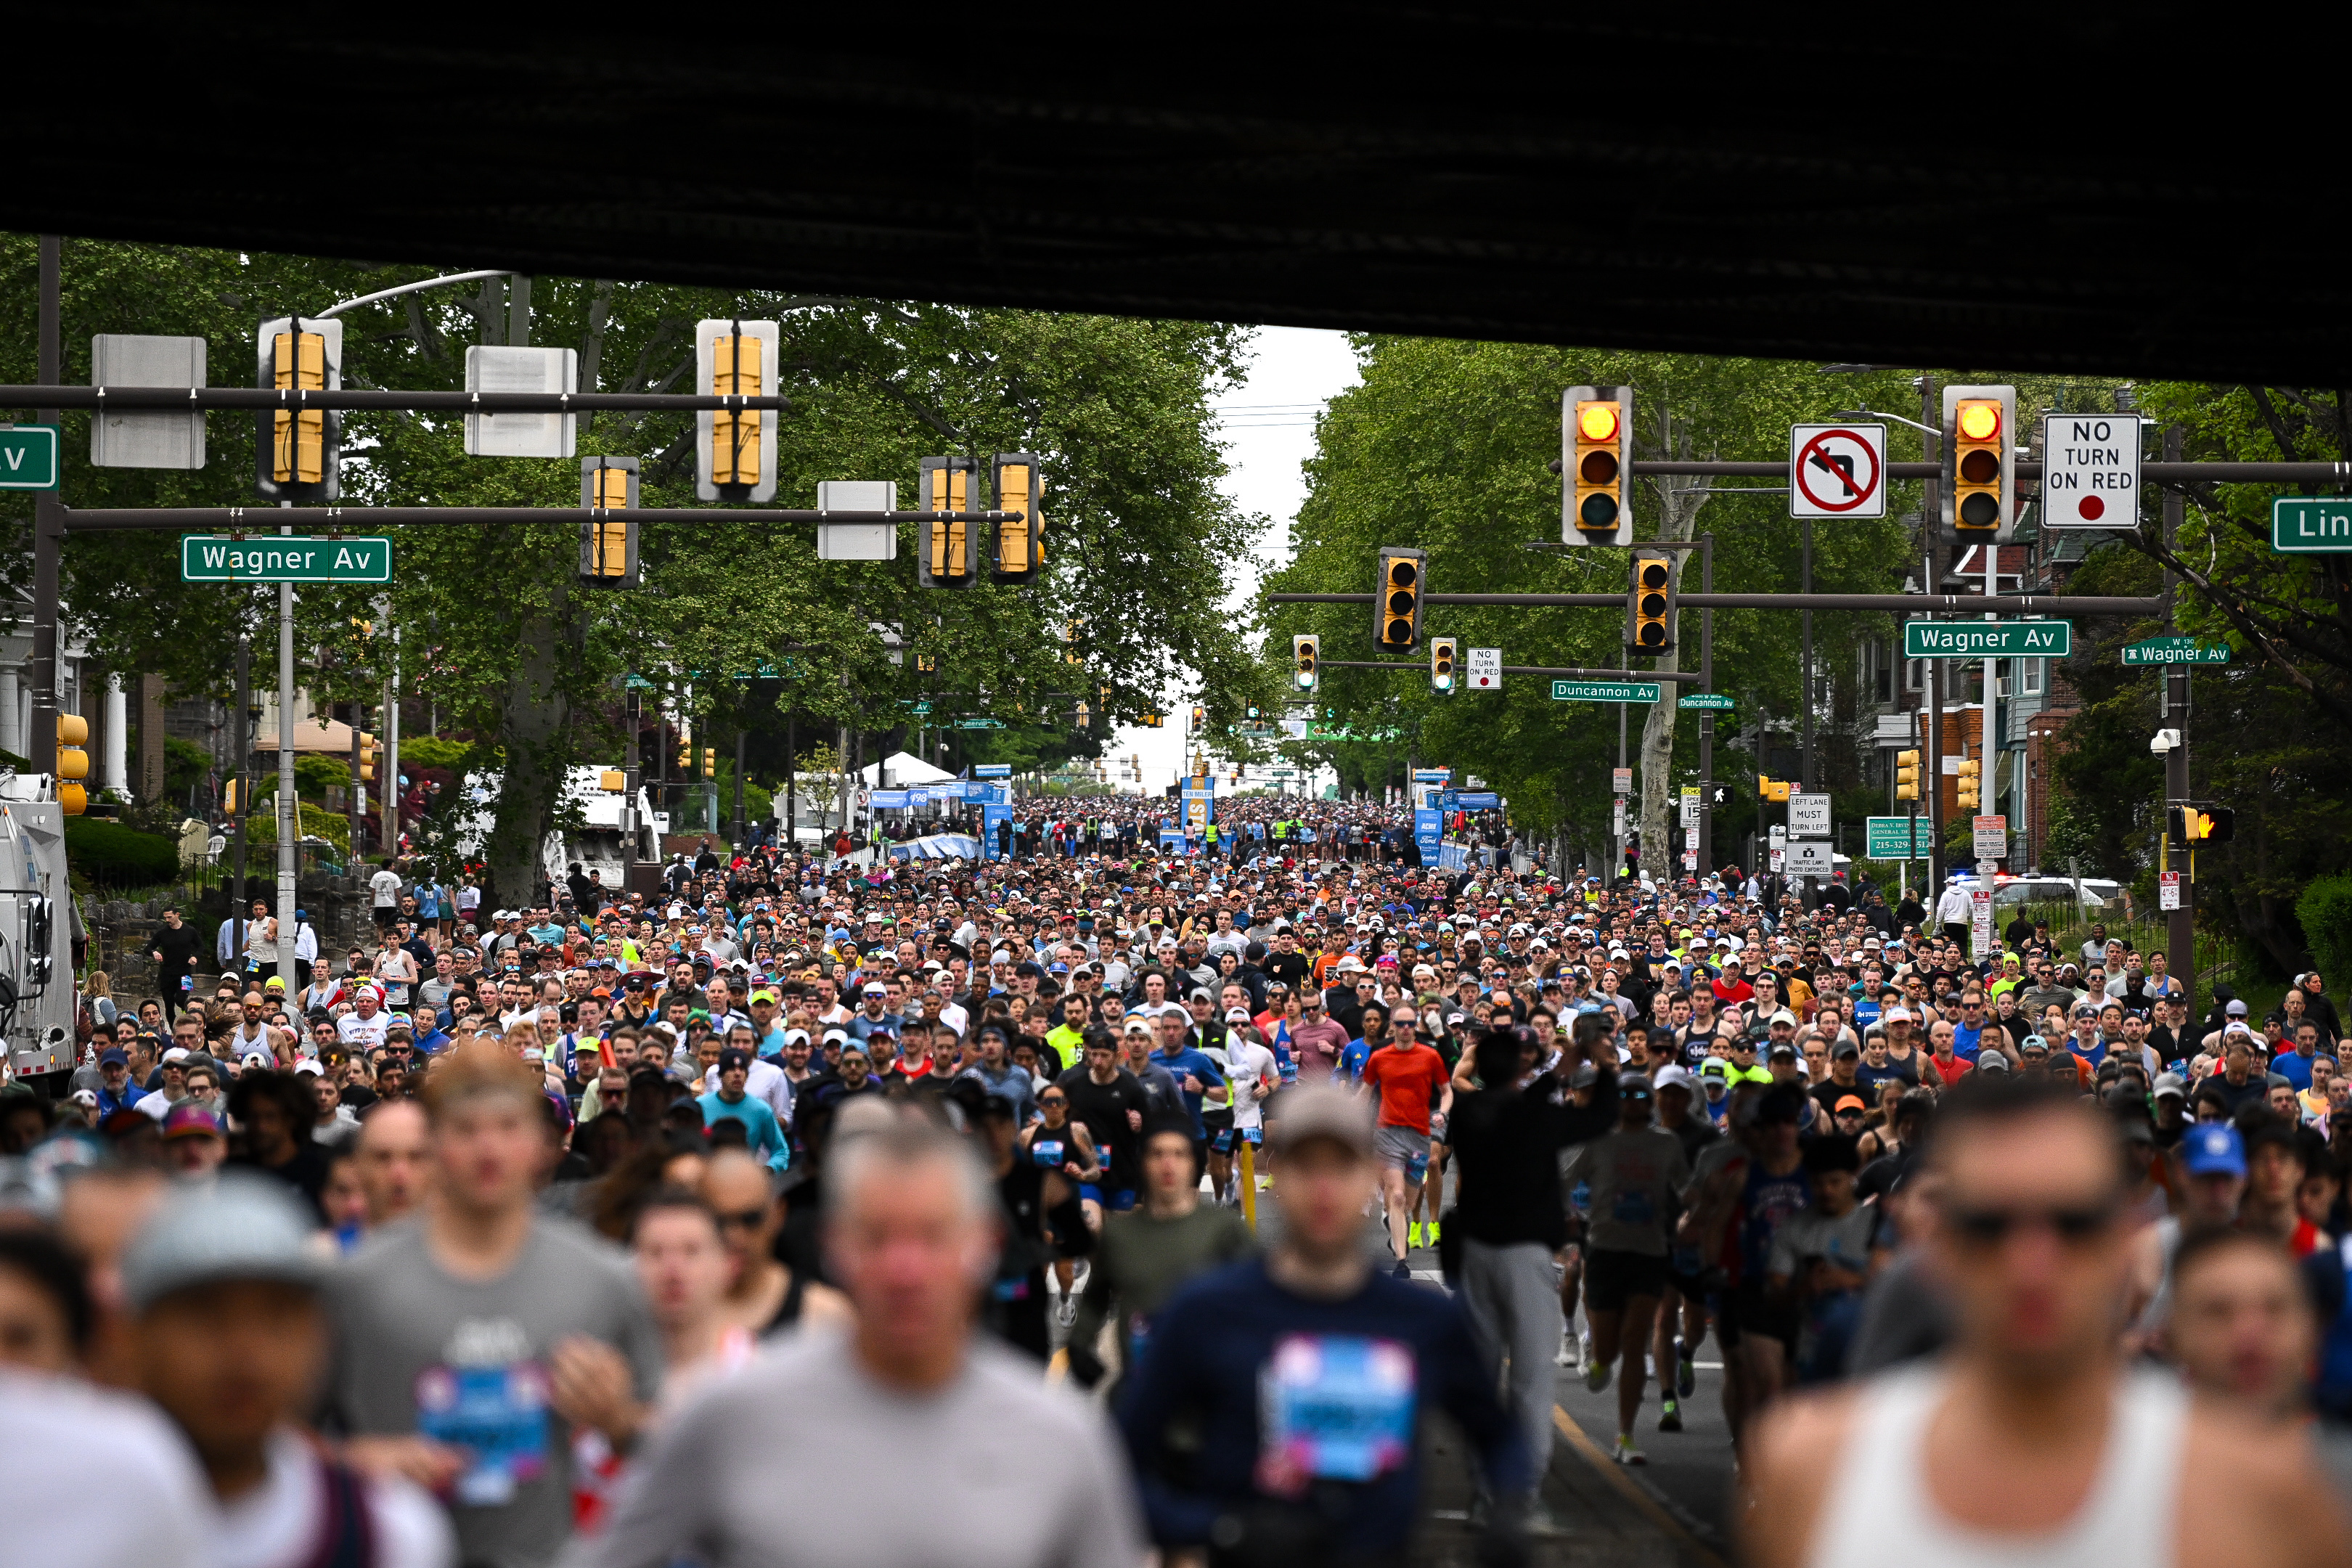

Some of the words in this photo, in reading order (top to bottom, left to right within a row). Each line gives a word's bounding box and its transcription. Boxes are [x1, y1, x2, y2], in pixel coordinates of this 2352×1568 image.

[2073, 421, 2111, 442] NO
[0, 447, 25, 472] v
[2065, 448, 2119, 466] TURN
[2050, 472, 2078, 489] ON
[2092, 472, 2132, 489] RED
[203, 546, 315, 574] Wagner
[333, 547, 371, 569] Av
[1921, 629, 2010, 652] Wagner
[2024, 629, 2054, 647] Av
[2141, 647, 2201, 663] Wagner
[2208, 648, 2227, 660] Av
[1558, 685, 1630, 697] Duncannon
[1637, 687, 1654, 698] Av
[1681, 698, 1722, 707] Duncannon
[1190, 804, 1205, 831] STA
[1688, 807, 1701, 818] 15
[1797, 810, 1822, 819] MUST
[1421, 835, 1437, 844] Ford
